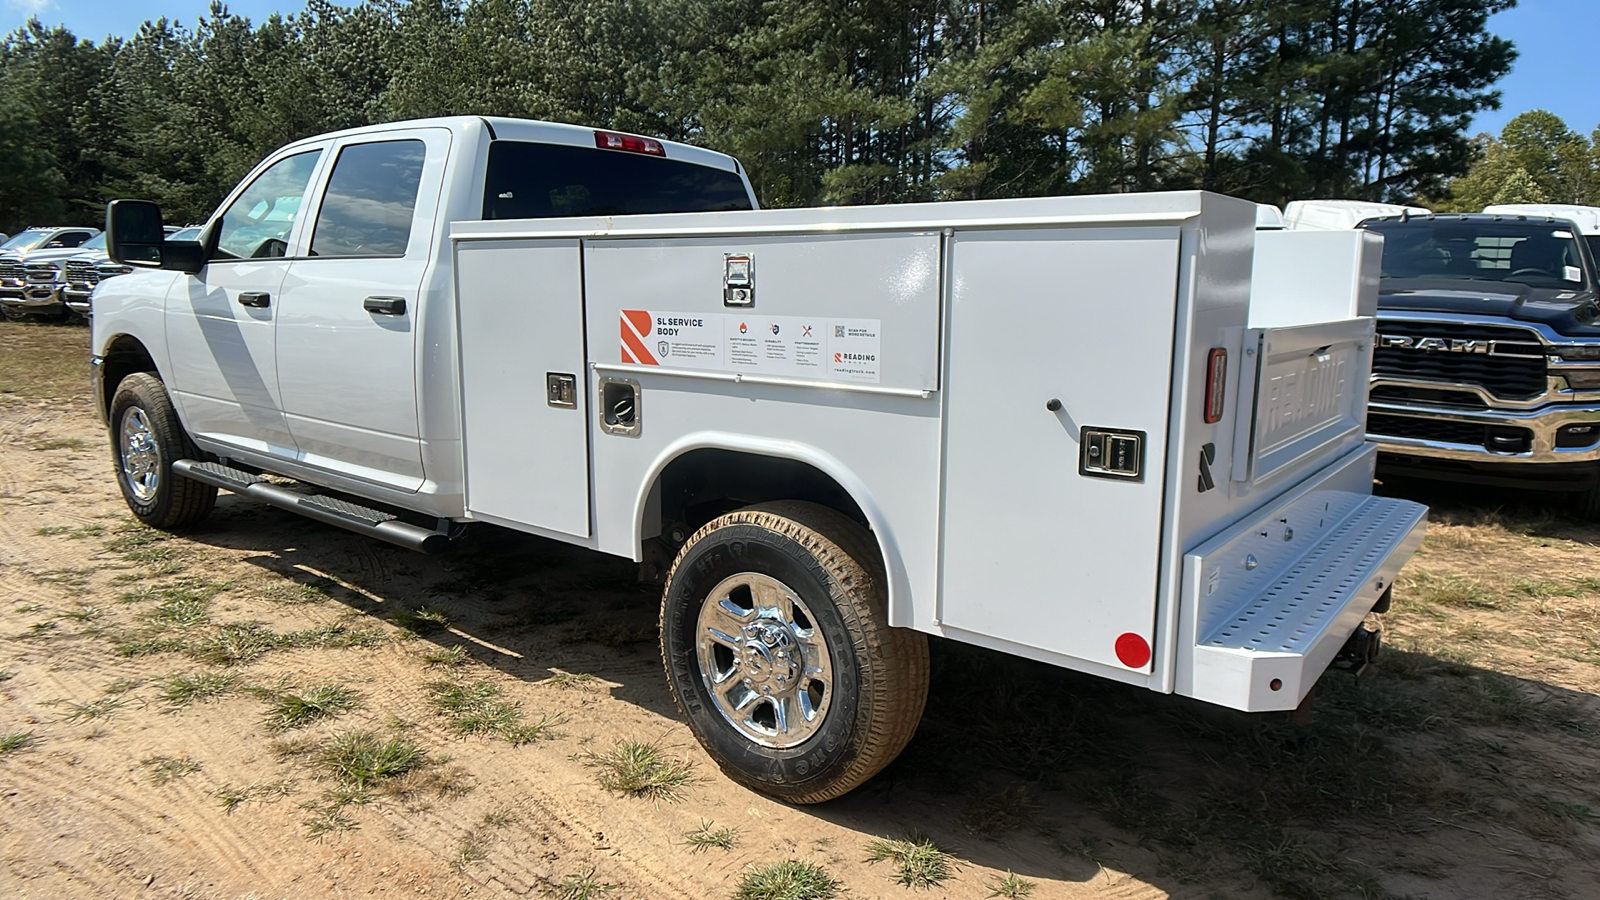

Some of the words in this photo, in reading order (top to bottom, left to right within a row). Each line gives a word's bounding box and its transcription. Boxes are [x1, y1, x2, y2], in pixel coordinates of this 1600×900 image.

[657, 317, 668, 326] SL
[668, 318, 703, 327] SERVICE
[657, 327, 679, 336] BODY
[1381, 334, 1489, 355] RAM
[843, 353, 875, 361] READING
